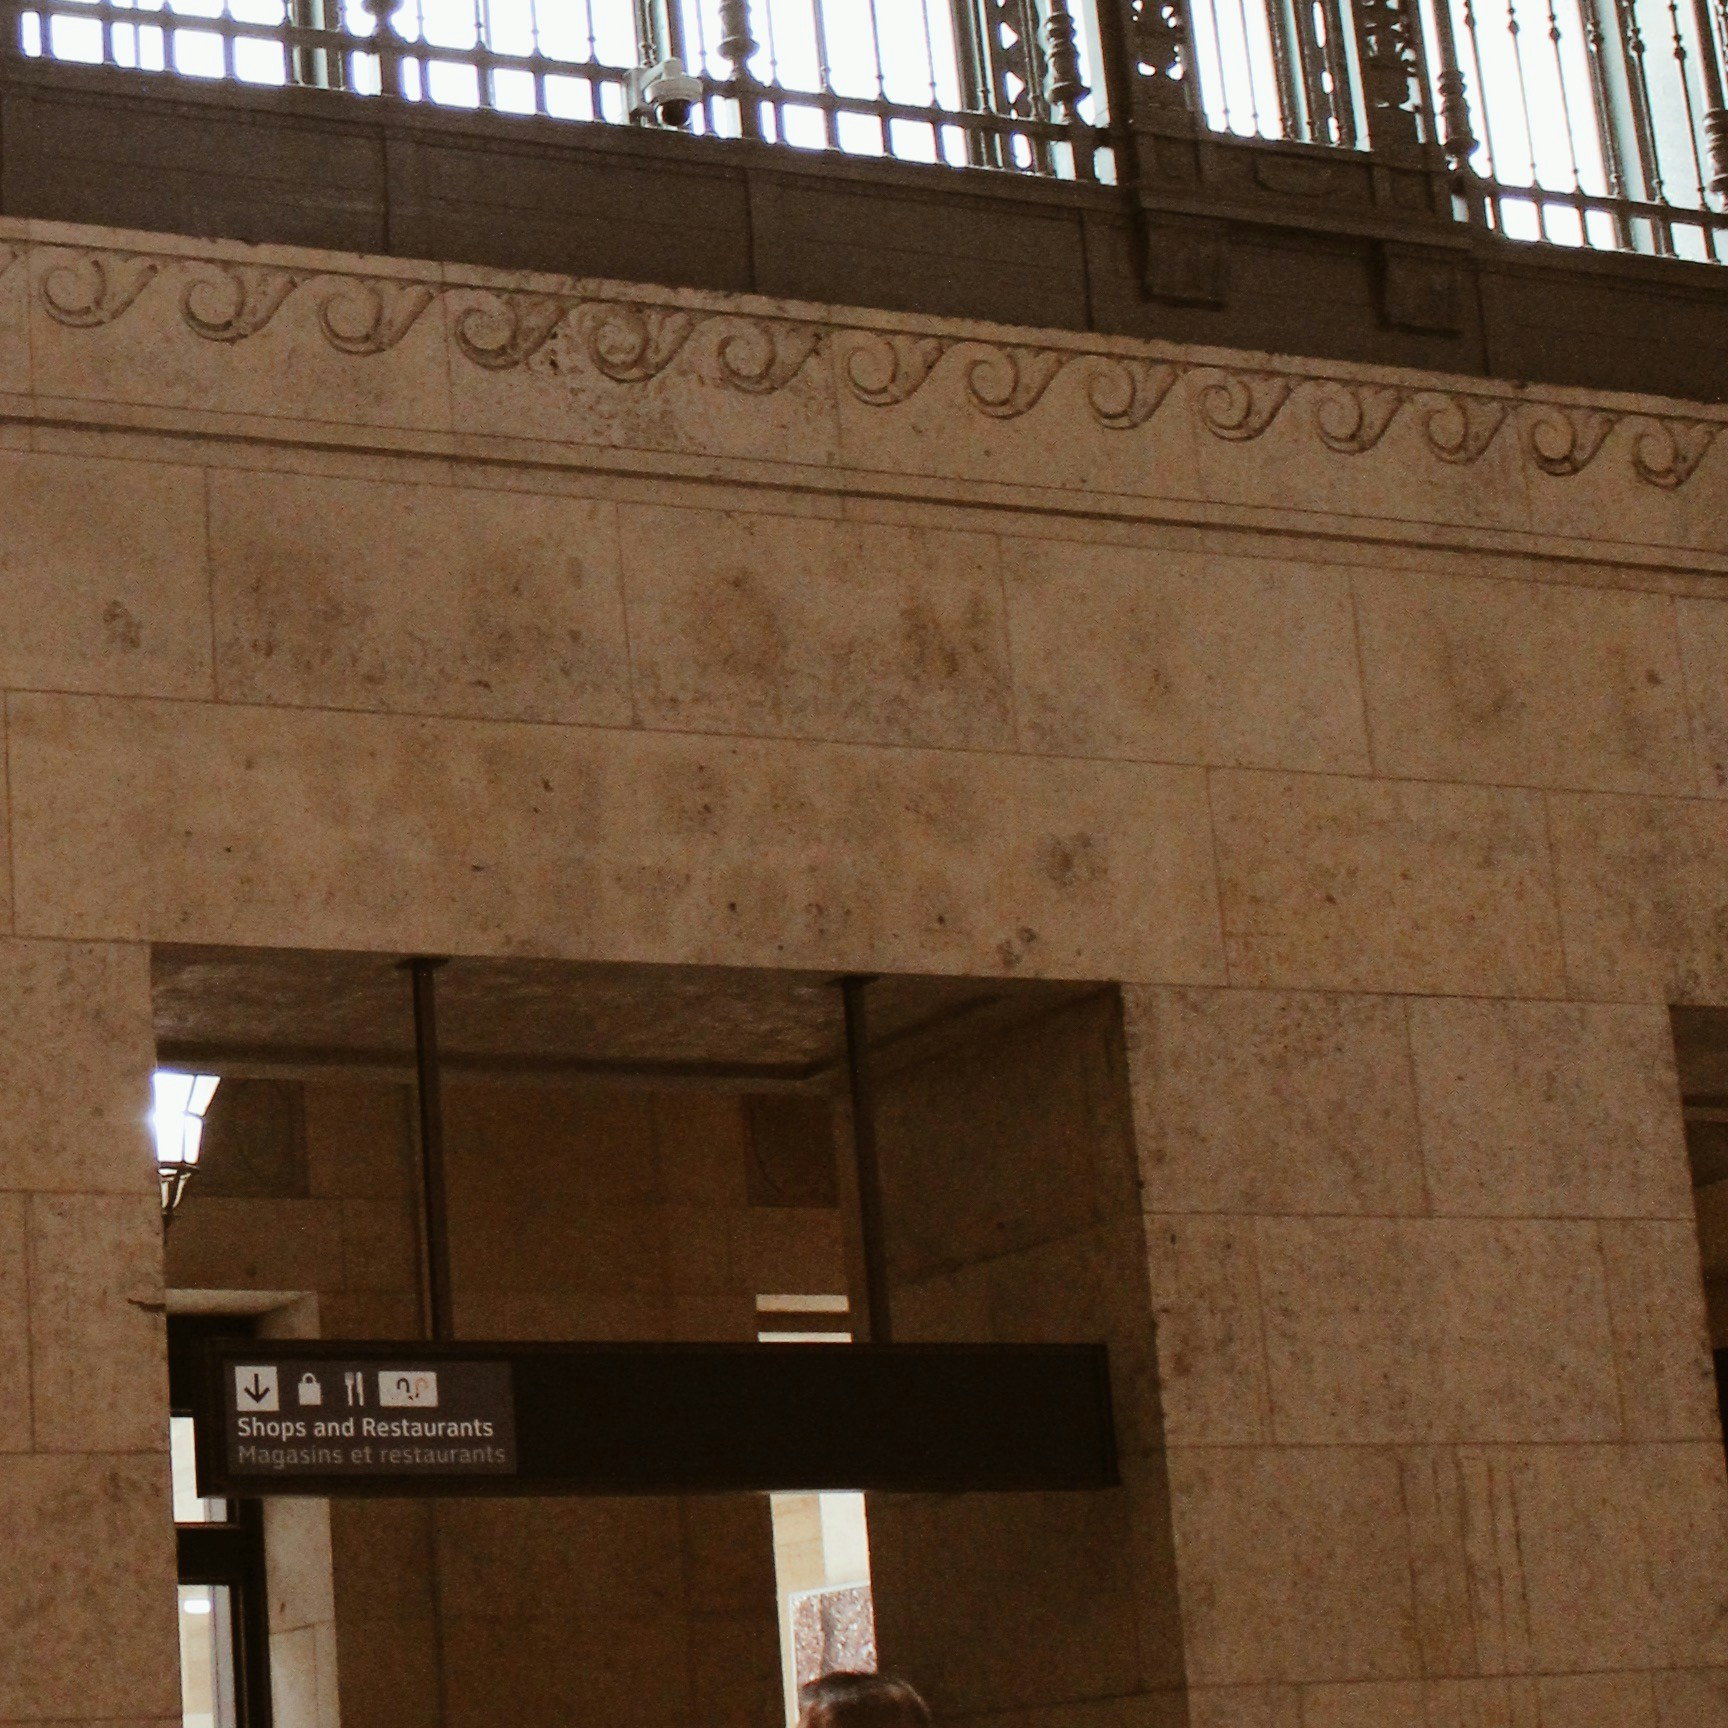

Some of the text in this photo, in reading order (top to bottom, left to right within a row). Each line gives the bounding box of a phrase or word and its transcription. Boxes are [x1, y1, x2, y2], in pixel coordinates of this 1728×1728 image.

[237, 1417, 495, 1443] Shops and Restaurants
[237, 1445, 507, 1470] Magasins et restaurants
